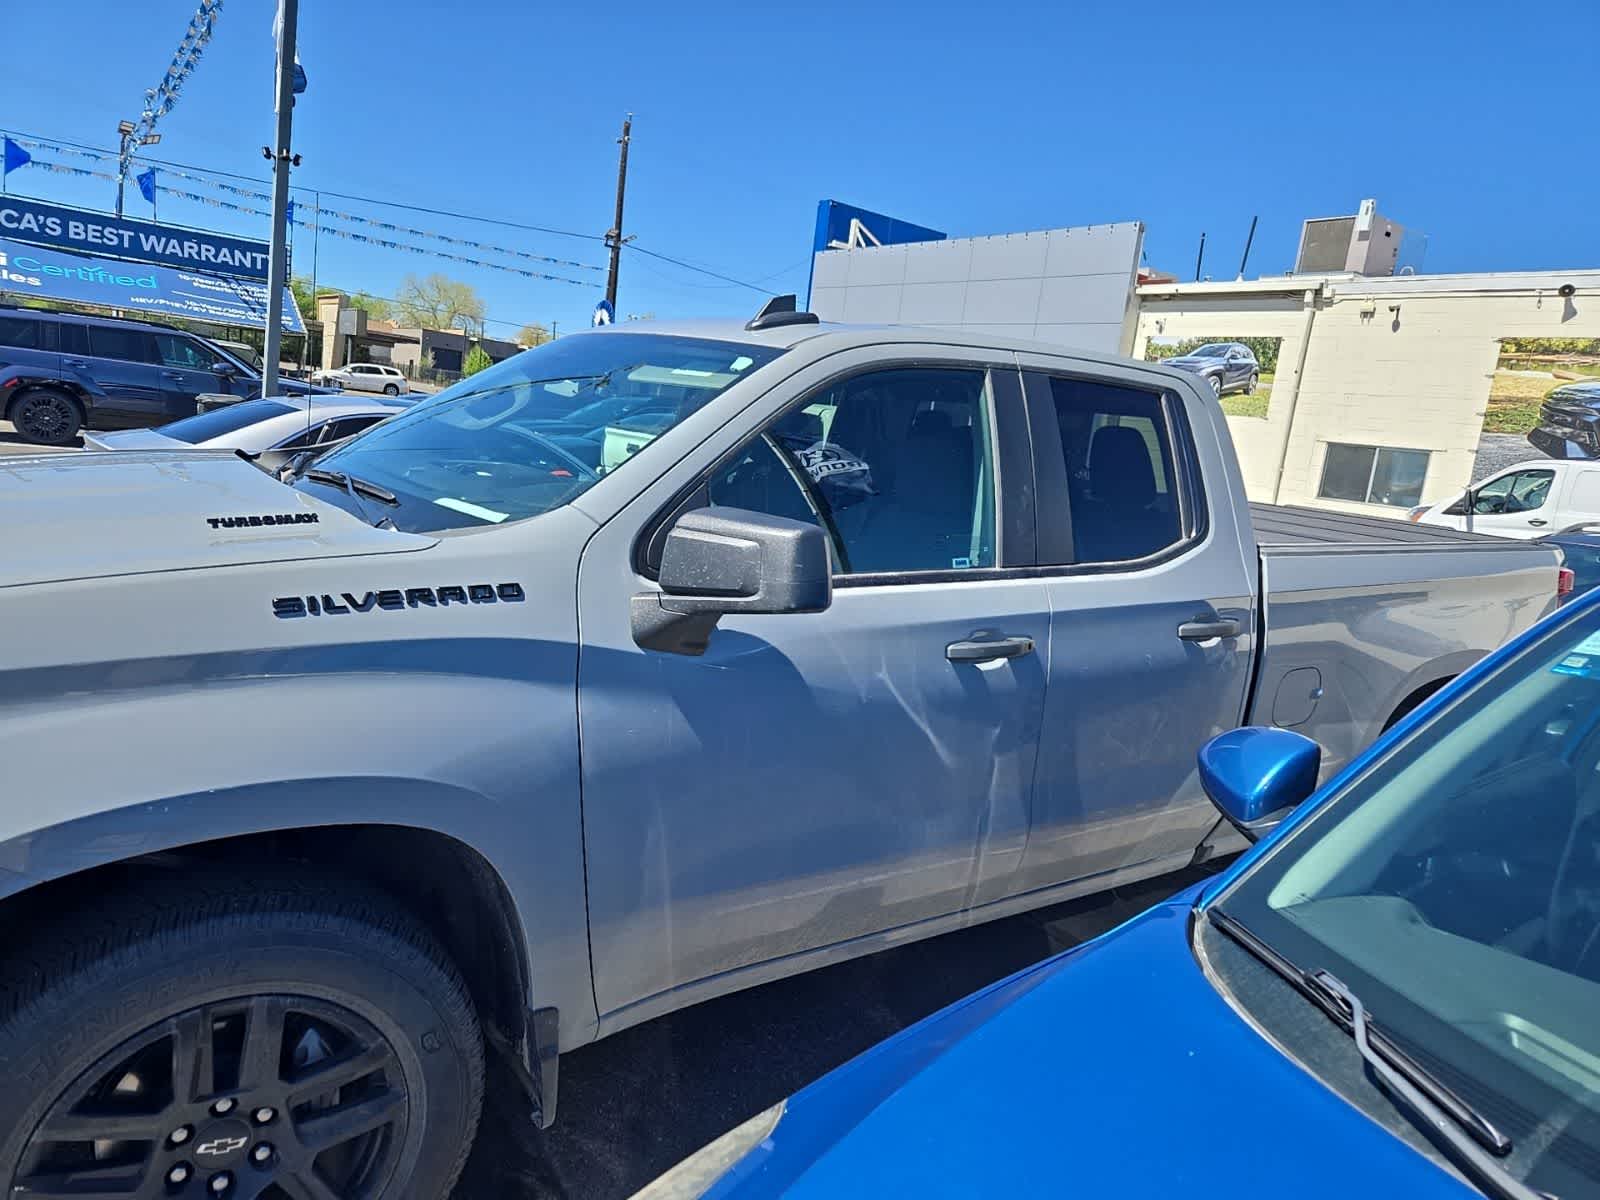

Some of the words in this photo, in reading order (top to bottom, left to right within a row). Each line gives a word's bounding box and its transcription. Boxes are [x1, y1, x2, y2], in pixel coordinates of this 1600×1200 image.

[0, 208, 62, 237] CA'S
[69, 221, 134, 248] BEST
[139, 233, 270, 270] WARRANT
[13, 256, 157, 289] Certified
[207, 513, 319, 529] TURBOMAX
[272, 582, 526, 619] SILVERADO
